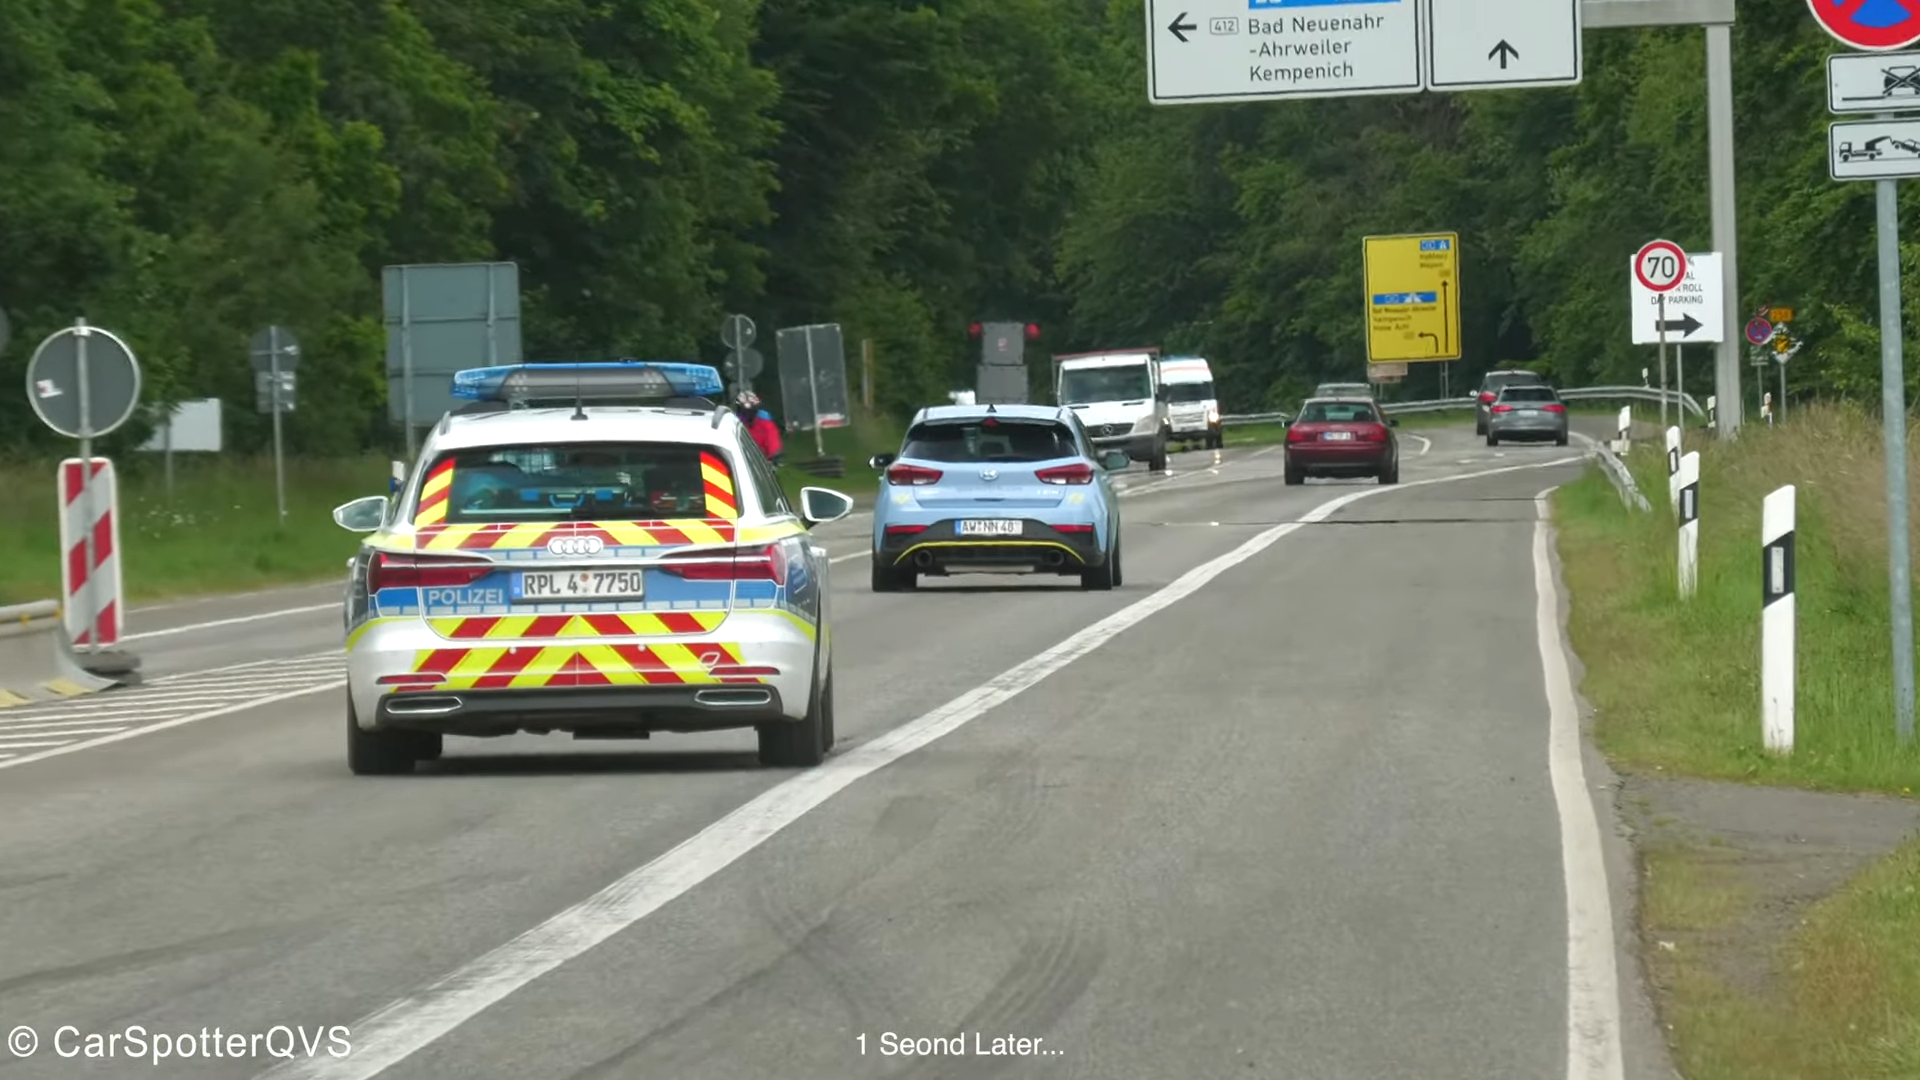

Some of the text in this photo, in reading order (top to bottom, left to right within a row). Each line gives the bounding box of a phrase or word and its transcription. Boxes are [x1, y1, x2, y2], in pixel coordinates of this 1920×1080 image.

[1214, 14, 1384, 35] 412 Bad Neuenahr
[1249, 40, 1352, 58] -Ahrweiler
[1249, 61, 1354, 83] Kempenich
[1647, 256, 1675, 279] 70
[1682, 283, 1703, 292] ROLL
[1668, 295, 1703, 305] PARKING
[524, 574, 561, 595] RPL
[567, 573, 578, 594] 4
[593, 571, 641, 594] 7750
[428, 588, 503, 605] POLIZEI
